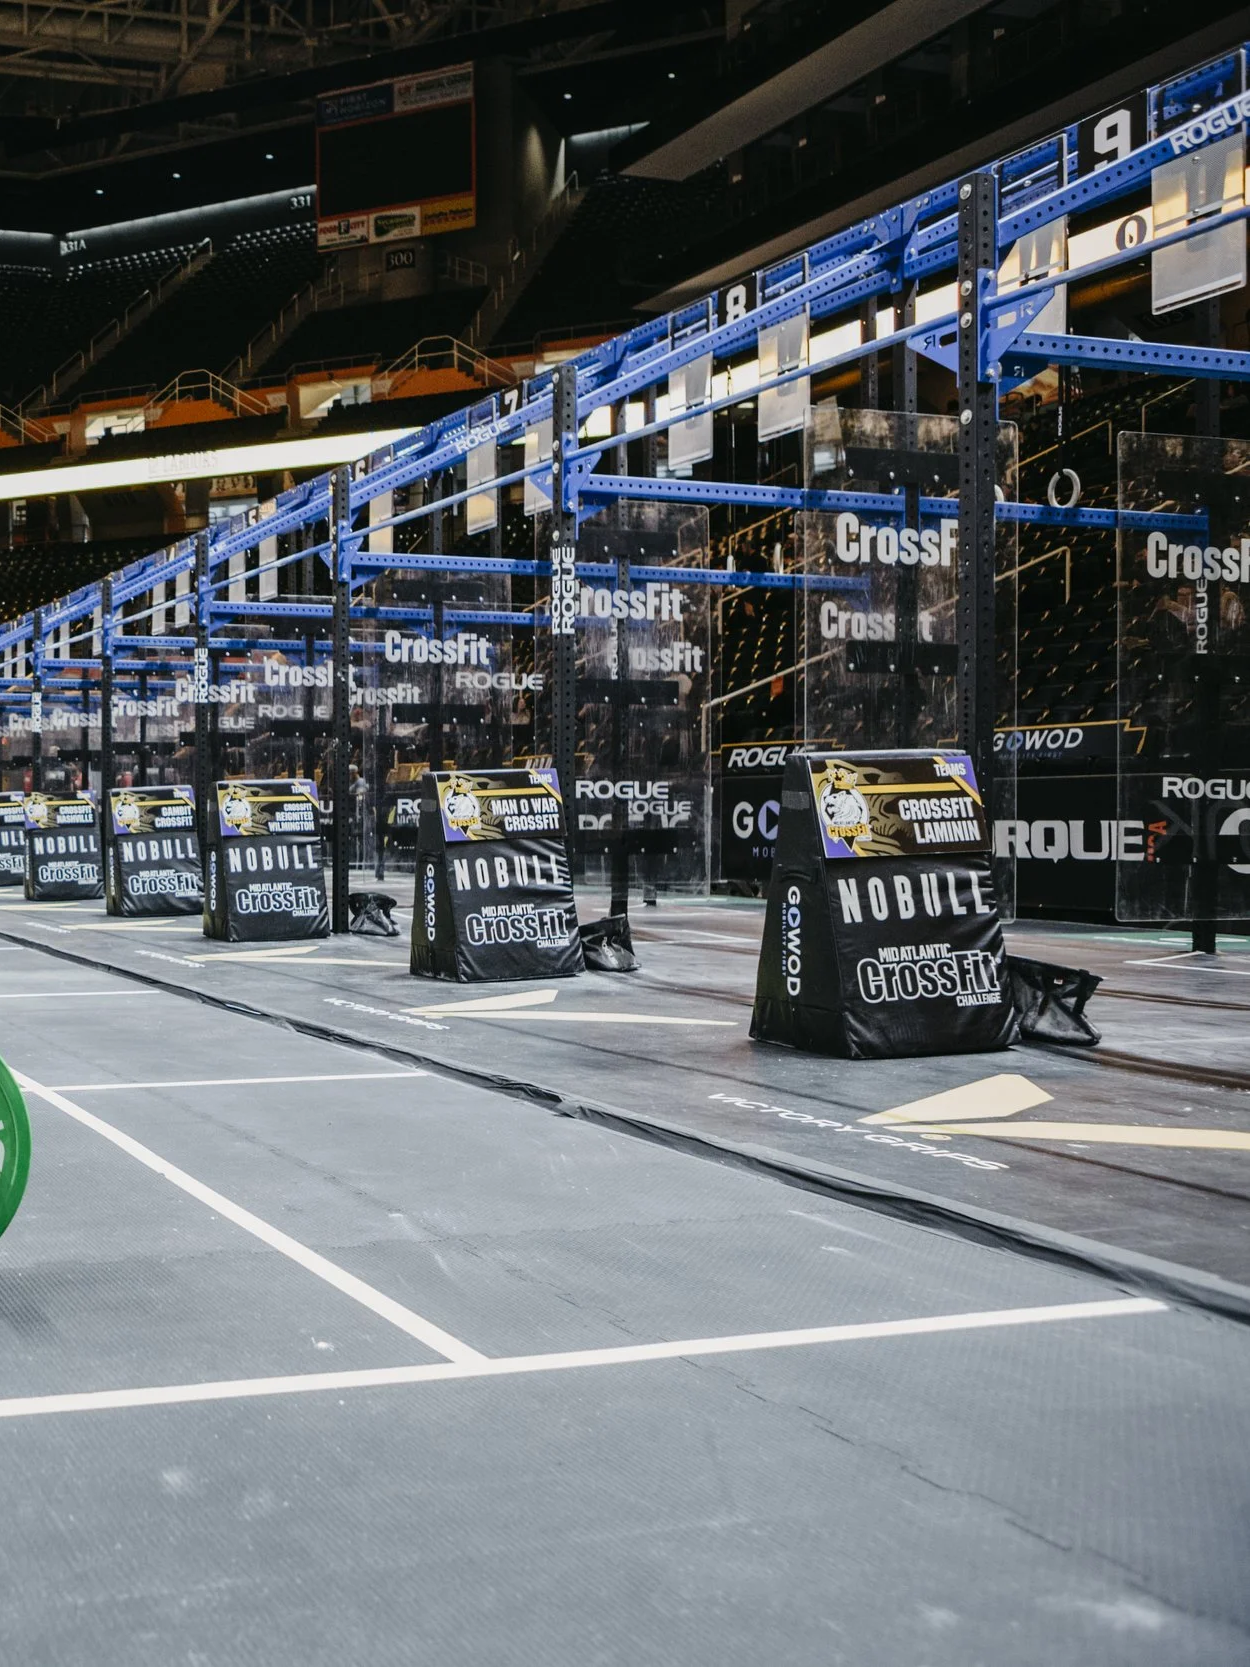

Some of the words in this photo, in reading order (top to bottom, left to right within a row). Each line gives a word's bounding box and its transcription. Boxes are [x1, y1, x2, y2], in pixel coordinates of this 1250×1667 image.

[291, 195, 310, 210] 331
[389, 248, 413, 268] 300
[561, 546, 575, 635] ROGUE
[575, 582, 684, 622] rossFit
[820, 601, 934, 643] Crosst
[1196, 579, 1208, 654] ROGUE
[385, 630, 490, 665] CrossFit
[199, 647, 208, 703] ROGUE
[456, 672, 544, 691] ROGUE
[258, 704, 330, 719] ROGE
[529, 774, 553, 785] TEAMS
[933, 763, 966, 776] TEAMS
[576, 780, 669, 799] ROGUE
[161, 806, 192, 817] GAMBIT
[275, 811, 314, 822] REIGNITED
[490, 799, 520, 816] MAN
[521, 799, 530, 815] O
[530, 797, 558, 814] WAR
[898, 797, 974, 821] CROSSFIT
[155, 816, 193, 828] CROSSFIT
[268, 821, 315, 832] WILMINGTON
[504, 814, 560, 832] CROSSFIT
[913, 820, 981, 844] LAMININ
[33, 835, 98, 855] NOBULL
[122, 838, 197, 863] NOBULL
[992, 820, 1145, 863] RQUE
[228, 844, 318, 873] NOBULL
[39, 863, 99, 883] CrossFit
[128, 872, 198, 896] CrossFit
[453, 854, 566, 891] NOBULL
[235, 886, 320, 914] CrossFit
[426, 863, 436, 942] GOWOD
[837, 871, 991, 924] NOBULL
[481, 906, 498, 919] MID
[497, 903, 536, 917] ATLANTIC
[465, 908, 569, 945] CrossFit
[787, 885, 801, 996] GOWOD
[878, 946, 900, 963] MID
[900, 943, 952, 962] ATLANTIC
[857, 949, 1001, 1004] CrossFit
[956, 992, 1002, 1007] CHALLENGE
[708, 1093, 871, 1134] VICTORY
[864, 1133, 1010, 1170] GRIPS
